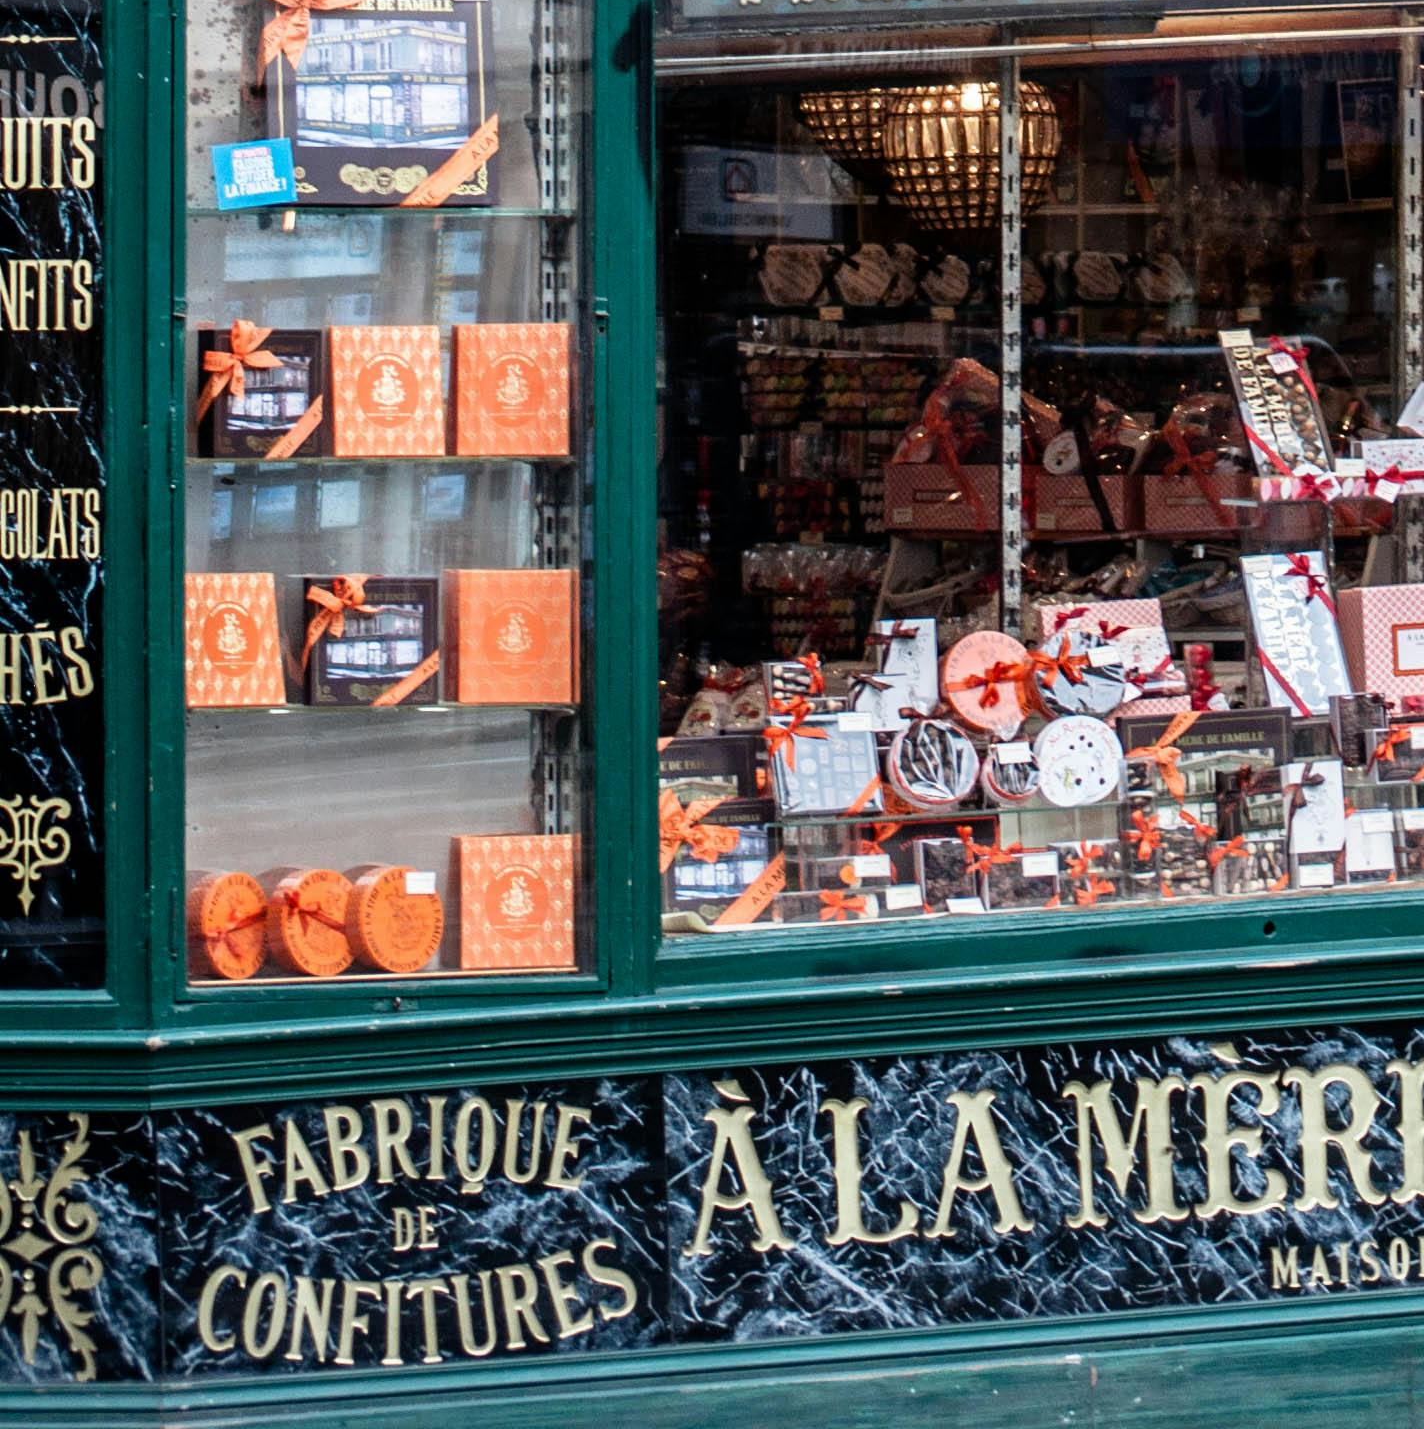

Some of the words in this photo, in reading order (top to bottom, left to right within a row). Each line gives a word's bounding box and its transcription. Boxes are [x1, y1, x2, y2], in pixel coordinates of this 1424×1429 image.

[0, 116, 96, 190] UITS
[233, 1096, 592, 1214] FABRIQUE
[681, 1080, 794, 1258] À
[820, 1089, 1036, 1247] LA
[392, 1205, 440, 1251] DE
[199, 1238, 638, 1366] CONFITURES
